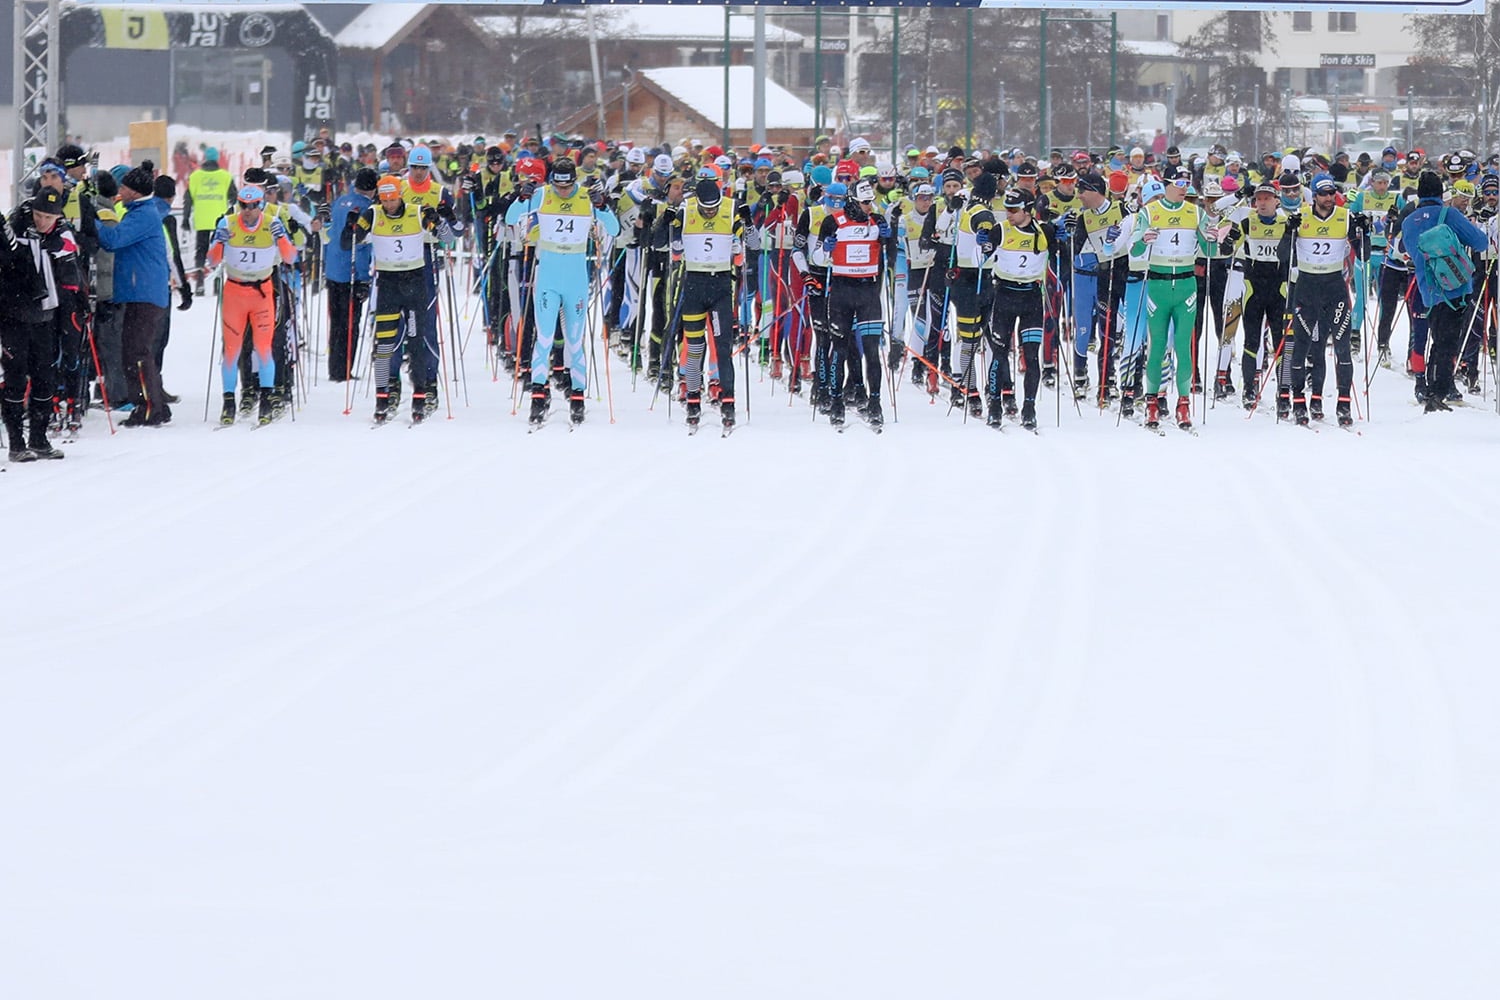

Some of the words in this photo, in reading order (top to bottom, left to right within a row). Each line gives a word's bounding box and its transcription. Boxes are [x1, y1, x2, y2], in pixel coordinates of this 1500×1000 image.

[1320, 55, 1338, 65] tion
[1340, 55, 1353, 65] de
[1354, 55, 1374, 65] Skis
[555, 218, 574, 233] 24
[704, 238, 713, 252] 5
[1170, 232, 1180, 246] 4
[394, 240, 403, 254] 3
[1257, 245, 1278, 257] 208
[1312, 242, 1331, 255] 22
[240, 251, 256, 263] 21
[1019, 255, 1028, 268] 2
